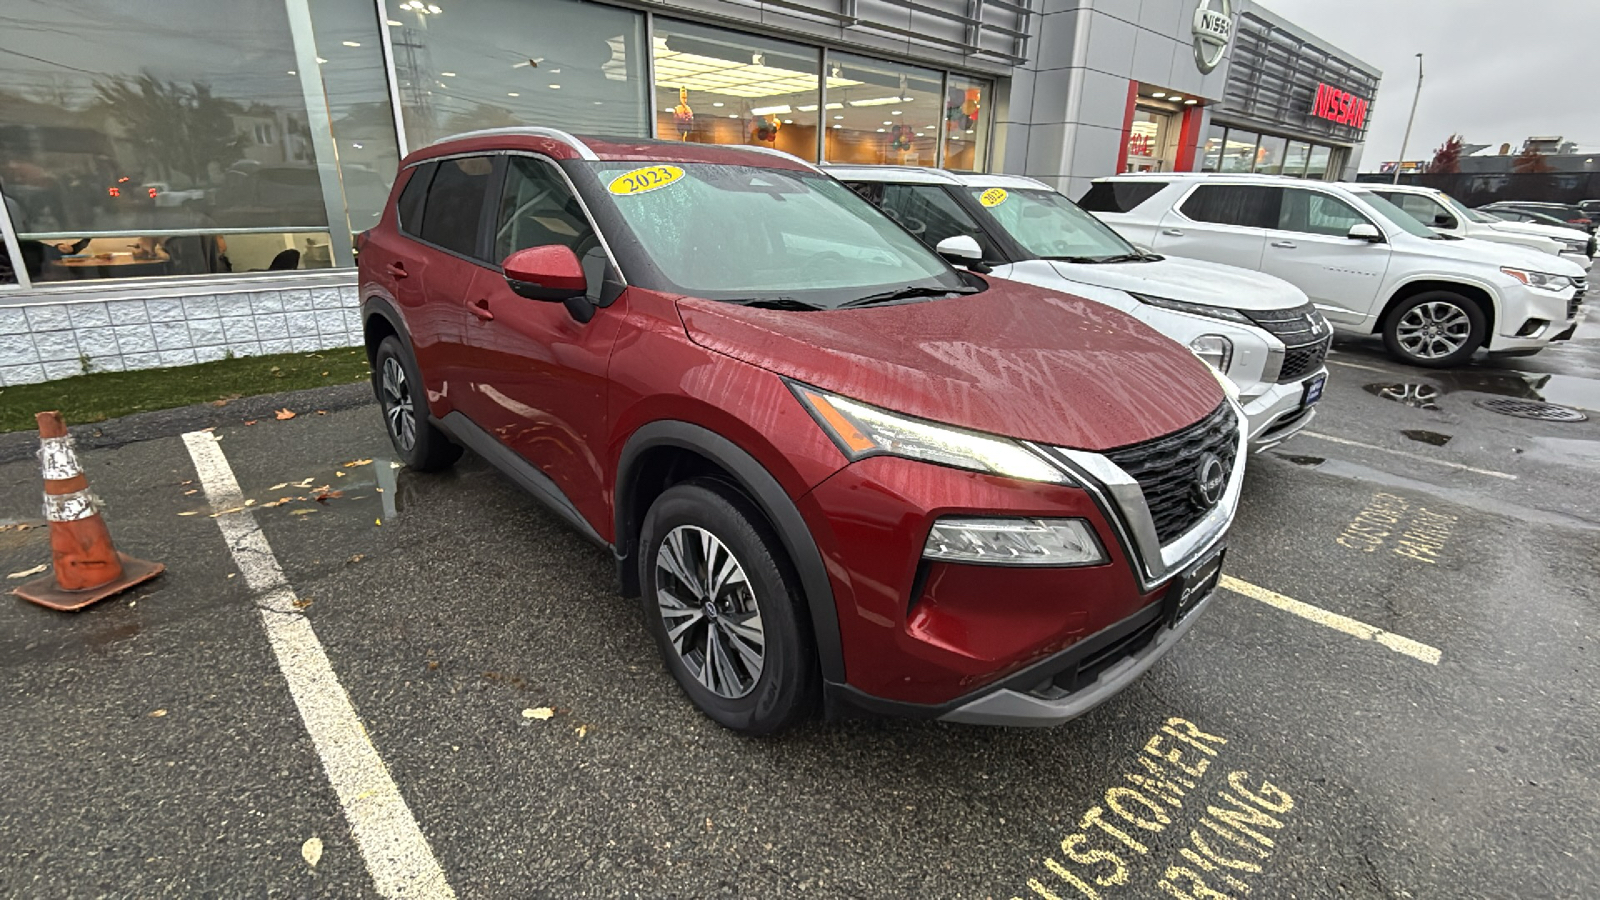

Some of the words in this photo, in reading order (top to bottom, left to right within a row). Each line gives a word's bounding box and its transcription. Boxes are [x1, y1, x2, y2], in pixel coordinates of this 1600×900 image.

[1312, 83, 1368, 129] NISSAN
[623, 168, 672, 192] 2023
[1009, 717, 1228, 900] USTOMER
[1158, 771, 1294, 900] RKING
